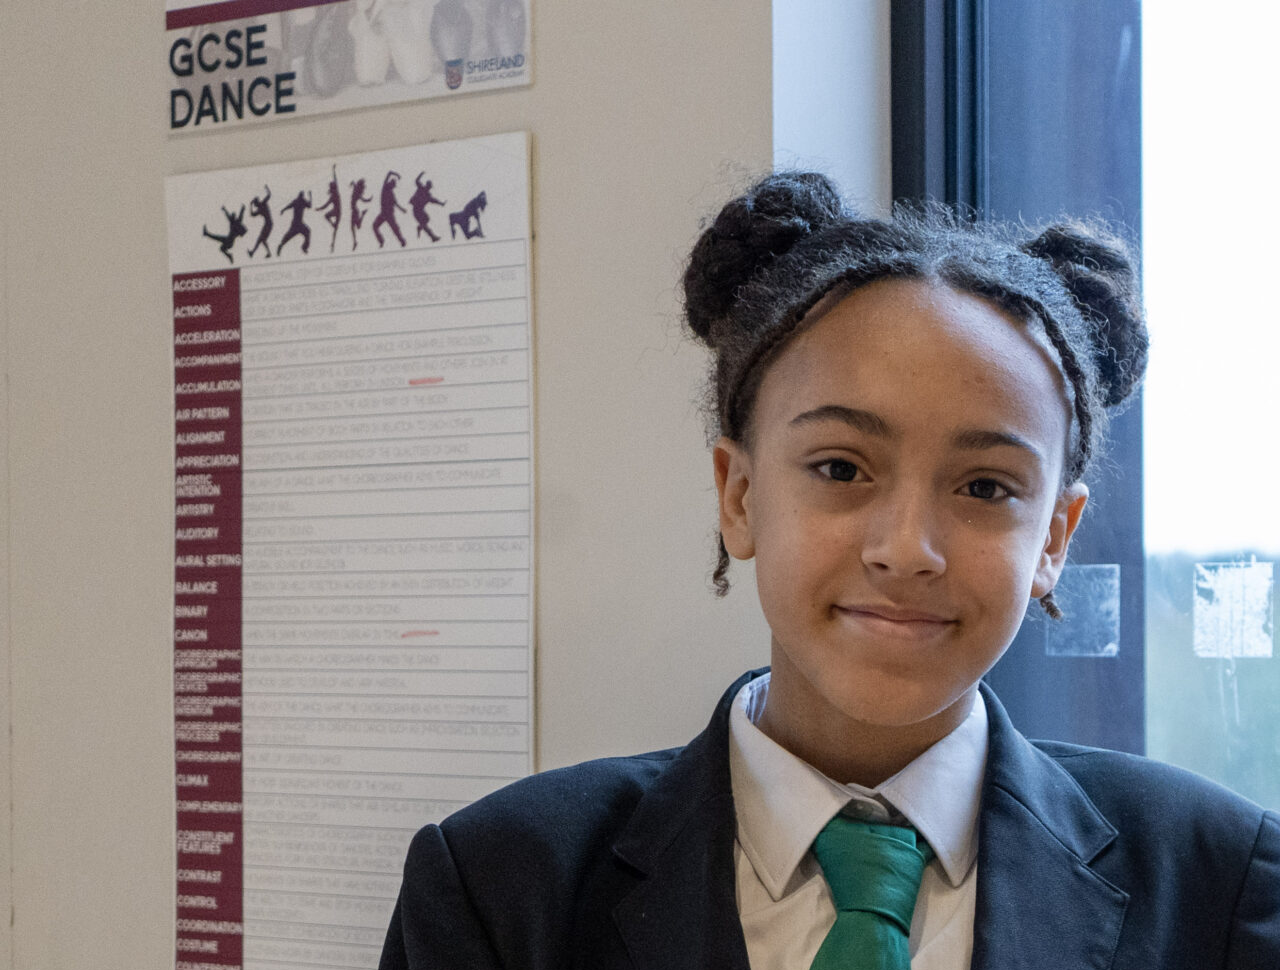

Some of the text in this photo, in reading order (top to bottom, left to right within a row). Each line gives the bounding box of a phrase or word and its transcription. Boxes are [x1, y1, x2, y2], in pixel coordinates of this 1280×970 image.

[169, 24, 267, 77] GCSE
[466, 53, 525, 74] SHIRELAND
[170, 72, 296, 129] DANCE
[174, 276, 226, 292] ACCESSORY
[174, 304, 212, 318] ACTIONS
[175, 329, 240, 345] ACCELERATION
[175, 379, 241, 394] ACCUMULATION
[176, 406, 230, 420] AIR PATTERN
[176, 430, 225, 444] ALIGNMENT
[176, 454, 240, 468] APPRECIATION
[176, 503, 215, 516] ARTISTRY
[176, 527, 219, 540] AUDITORY
[175, 555, 205, 567] AURAL
[206, 554, 242, 567] SETTING
[175, 581, 218, 594] BALANCE
[175, 605, 208, 617] BINARY
[175, 629, 208, 642] CANON
[176, 774, 209, 787] CLIMAX
[177, 869, 222, 883] CONTRAST
[177, 894, 218, 909] CONTROL
[177, 918, 243, 935] COORDINATION
[177, 938, 218, 954] COSTUME
